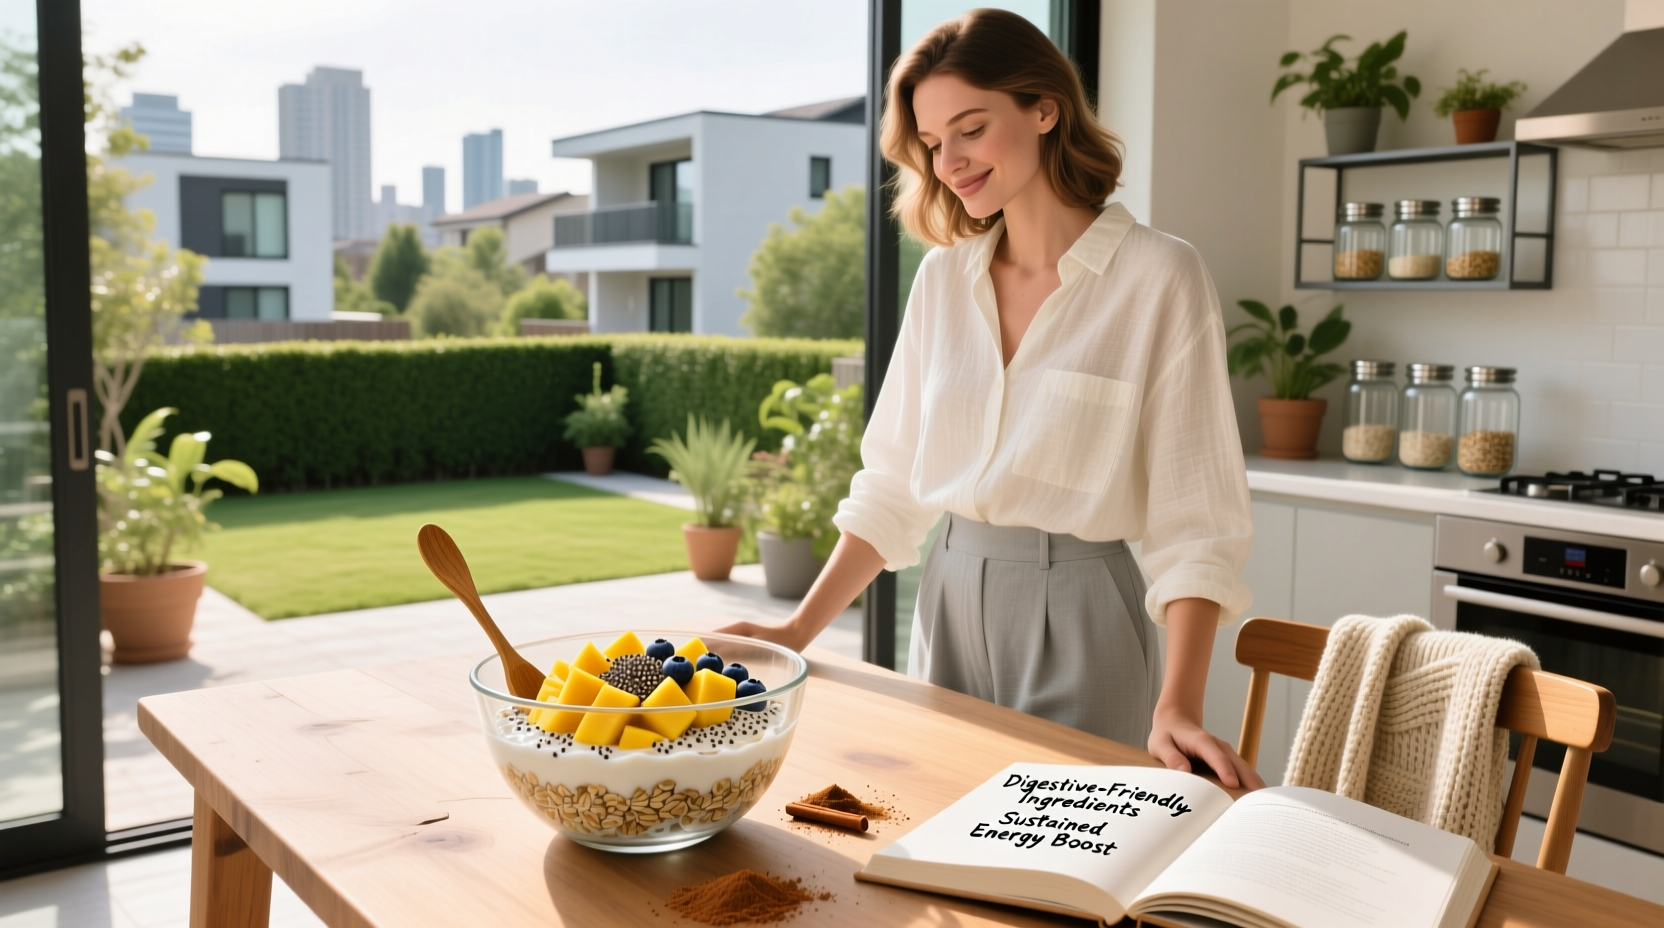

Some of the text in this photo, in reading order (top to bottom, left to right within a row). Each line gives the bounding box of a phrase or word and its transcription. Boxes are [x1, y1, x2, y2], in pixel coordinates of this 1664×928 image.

[1003, 774, 1192, 817] Digestive-Friendly
[1018, 789, 1141, 817] Ingredients
[999, 811, 1108, 836] Sustained
[970, 823, 1117, 855] Energy Boost
